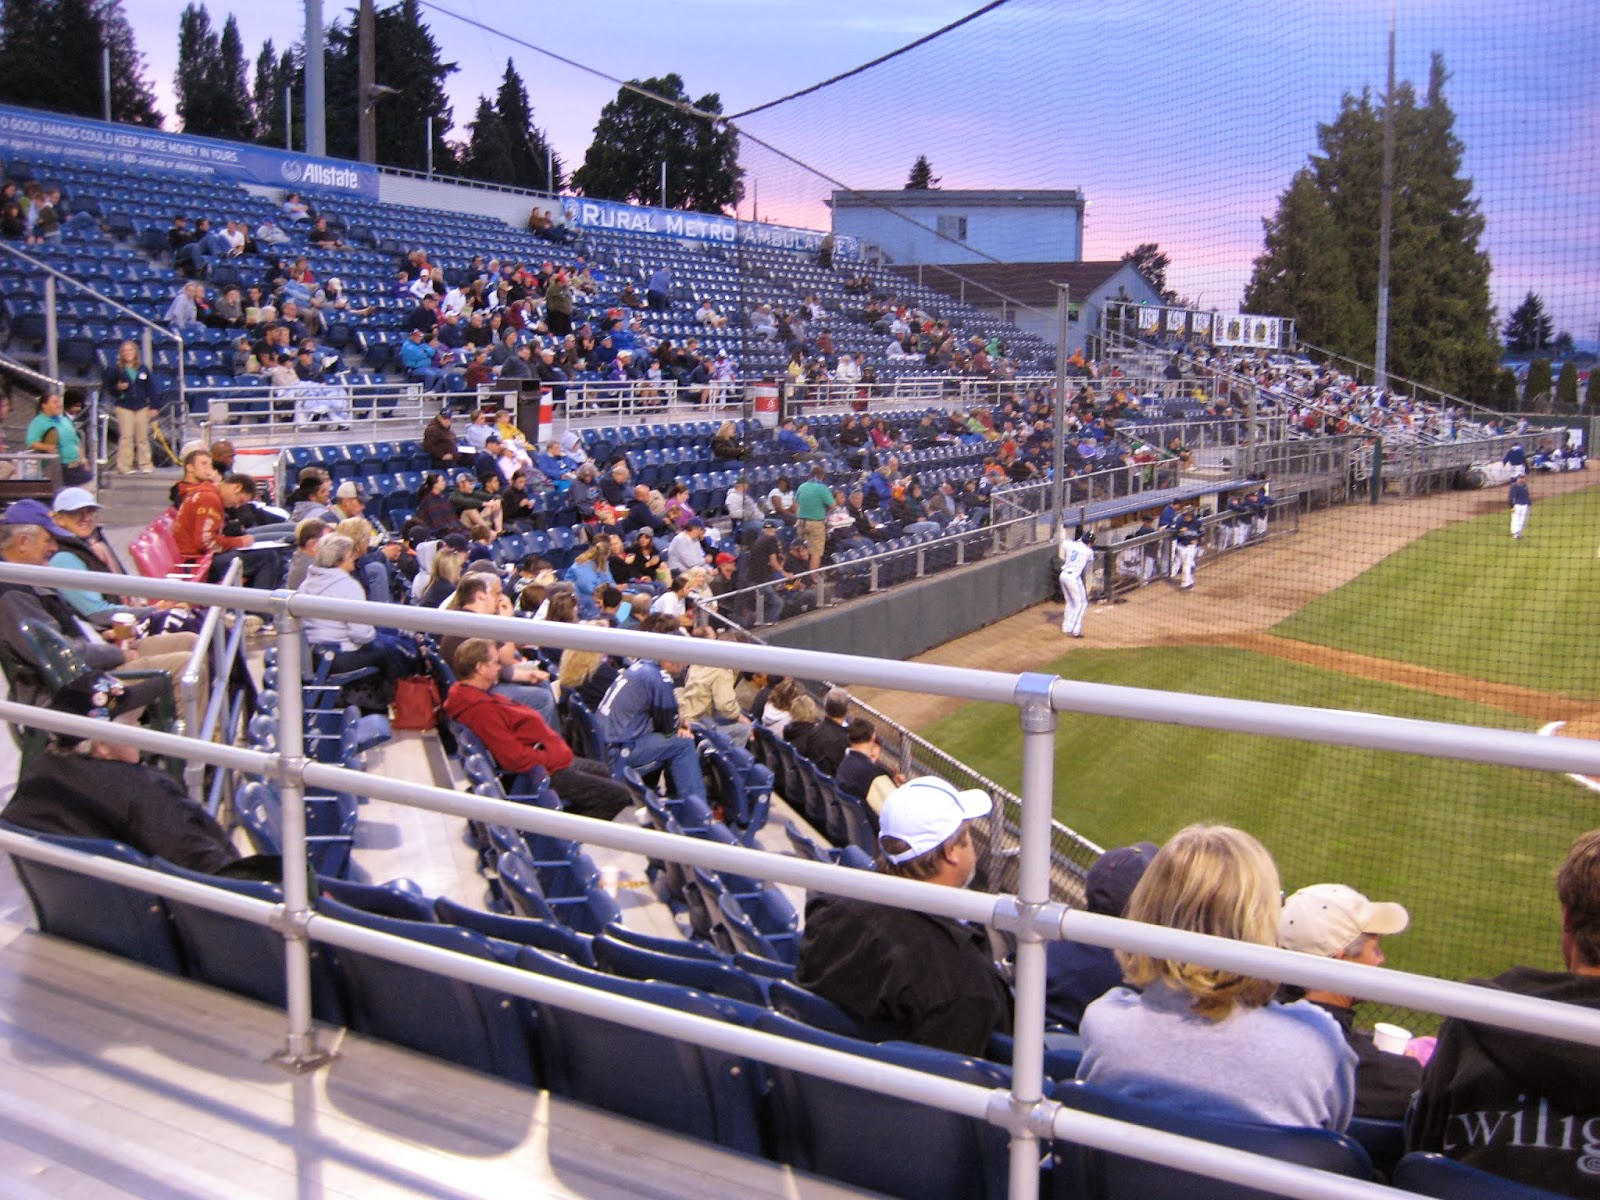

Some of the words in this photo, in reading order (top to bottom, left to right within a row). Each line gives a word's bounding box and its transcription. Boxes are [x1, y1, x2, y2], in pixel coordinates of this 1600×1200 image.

[10, 118, 41, 134] GOOD
[42, 122, 79, 140] HANDS
[80, 129, 113, 144] COULD
[114, 134, 139, 147] KEEP
[141, 139, 167, 152] MORE
[168, 142, 198, 157] MONEY
[199, 147, 210, 158] IN
[302, 163, 358, 189] Allstate
[582, 203, 657, 233] RURAL
[666, 214, 735, 242] METRO
[742, 226, 846, 255] AMBULANE
